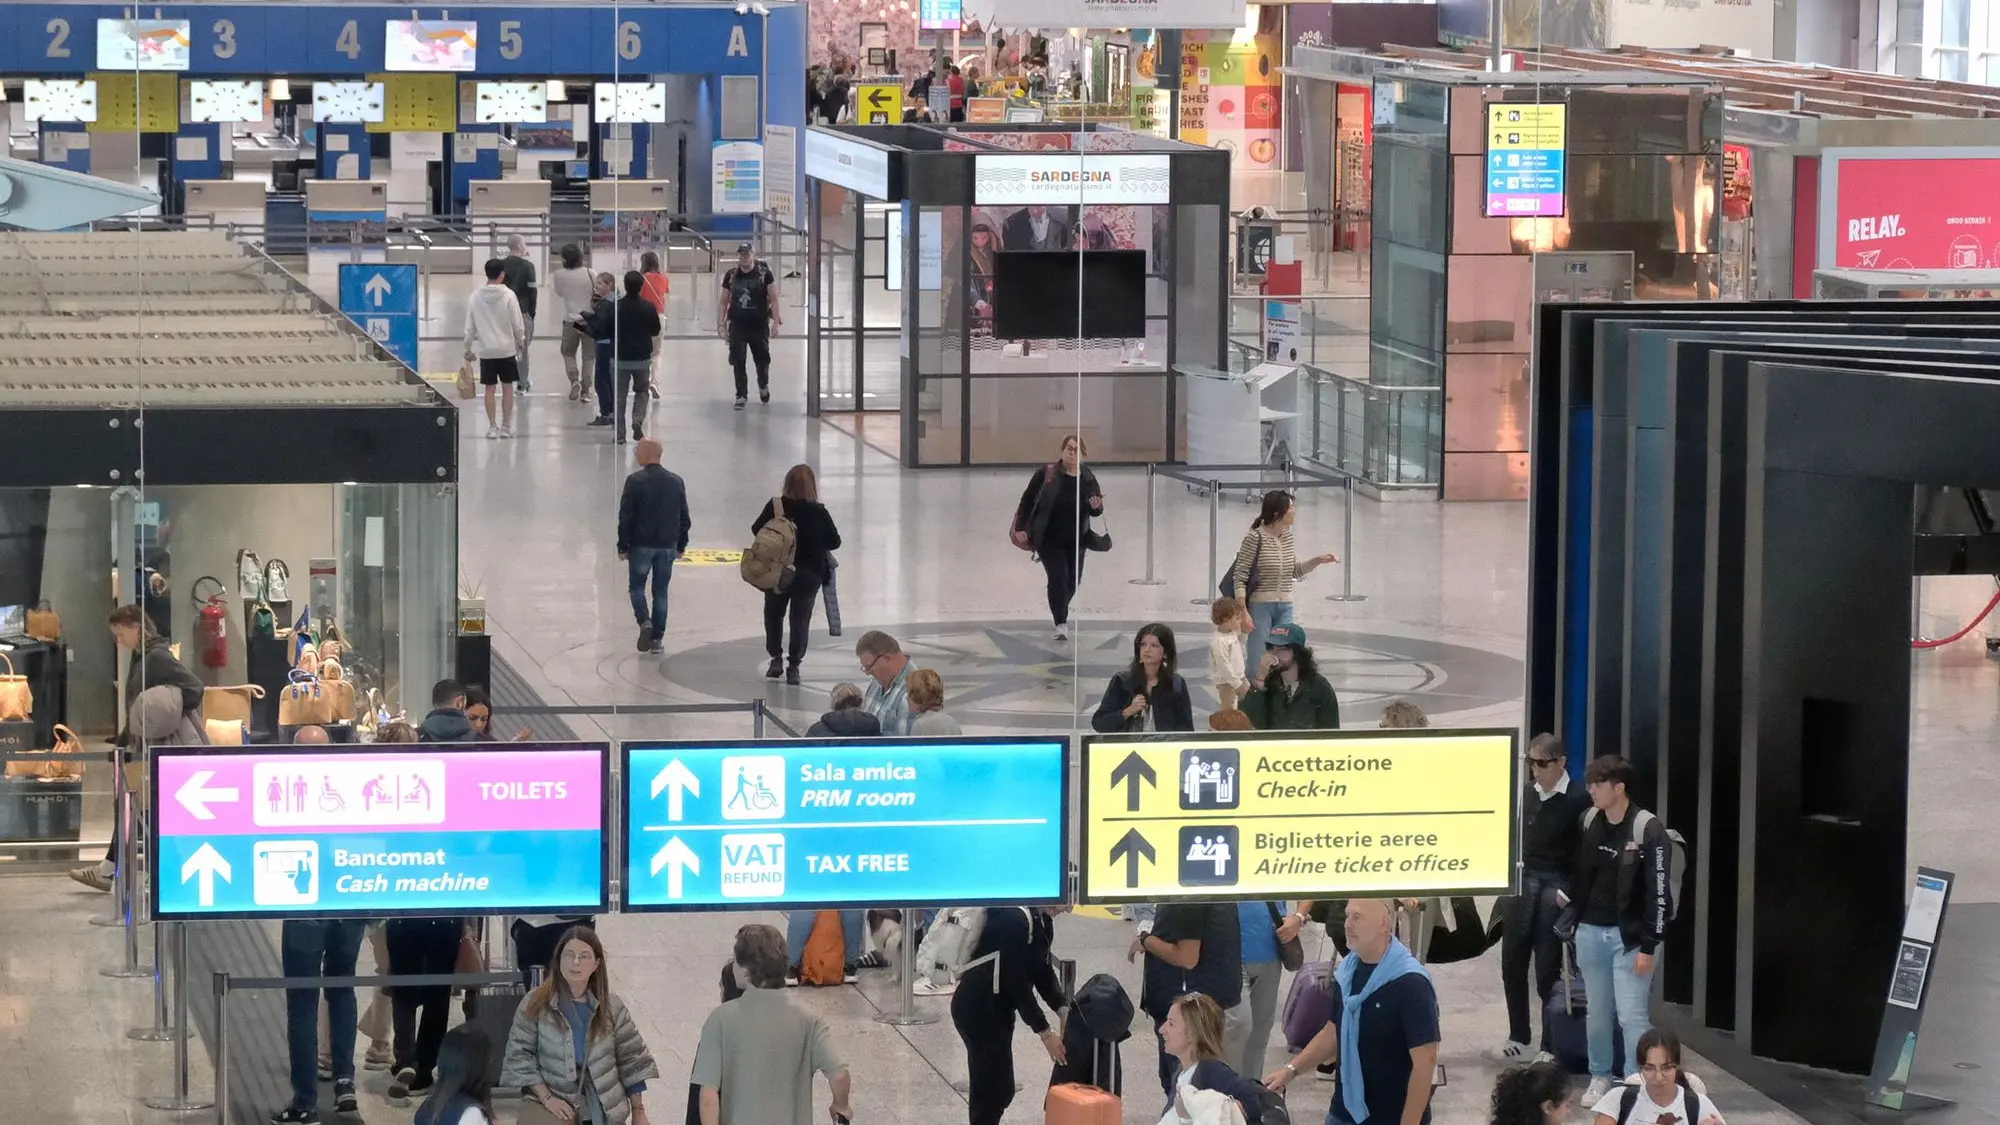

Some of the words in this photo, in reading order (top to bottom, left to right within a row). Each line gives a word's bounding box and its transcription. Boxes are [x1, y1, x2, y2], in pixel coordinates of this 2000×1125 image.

[46, 18, 71, 58] 2
[213, 19, 236, 59] 3
[336, 21, 360, 59] 4
[500, 21, 523, 60] 5
[618, 22, 642, 60] 6
[727, 26, 747, 56] A
[1031, 171, 1112, 182] SARDEGNA
[1031, 183, 1112, 192] sardegnatuismo.it
[800, 762, 846, 782] Sala
[852, 762, 916, 781] amica
[1255, 754, 1393, 773] Accettazione
[478, 781, 569, 801] TOILETS
[800, 789, 851, 808] PRM
[856, 790, 916, 807] room
[1256, 779, 1347, 799] Check-in
[1255, 832, 1373, 853] Biglietterie
[1379, 833, 1438, 848] aeree
[333, 848, 446, 867] Bancomat
[723, 843, 783, 867] VAT
[806, 855, 851, 874] TAX
[857, 853, 910, 873] FREE
[1254, 857, 1327, 875] Airline
[1334, 855, 1394, 873] ticket
[1399, 854, 1470, 873] offices
[1656, 847, 1665, 870] United
[335, 873, 389, 894] Cash
[394, 872, 490, 893] machine
[723, 871, 783, 885] REFUND
[1656, 871, 1666, 896] States
[1657, 897, 1666, 905] of
